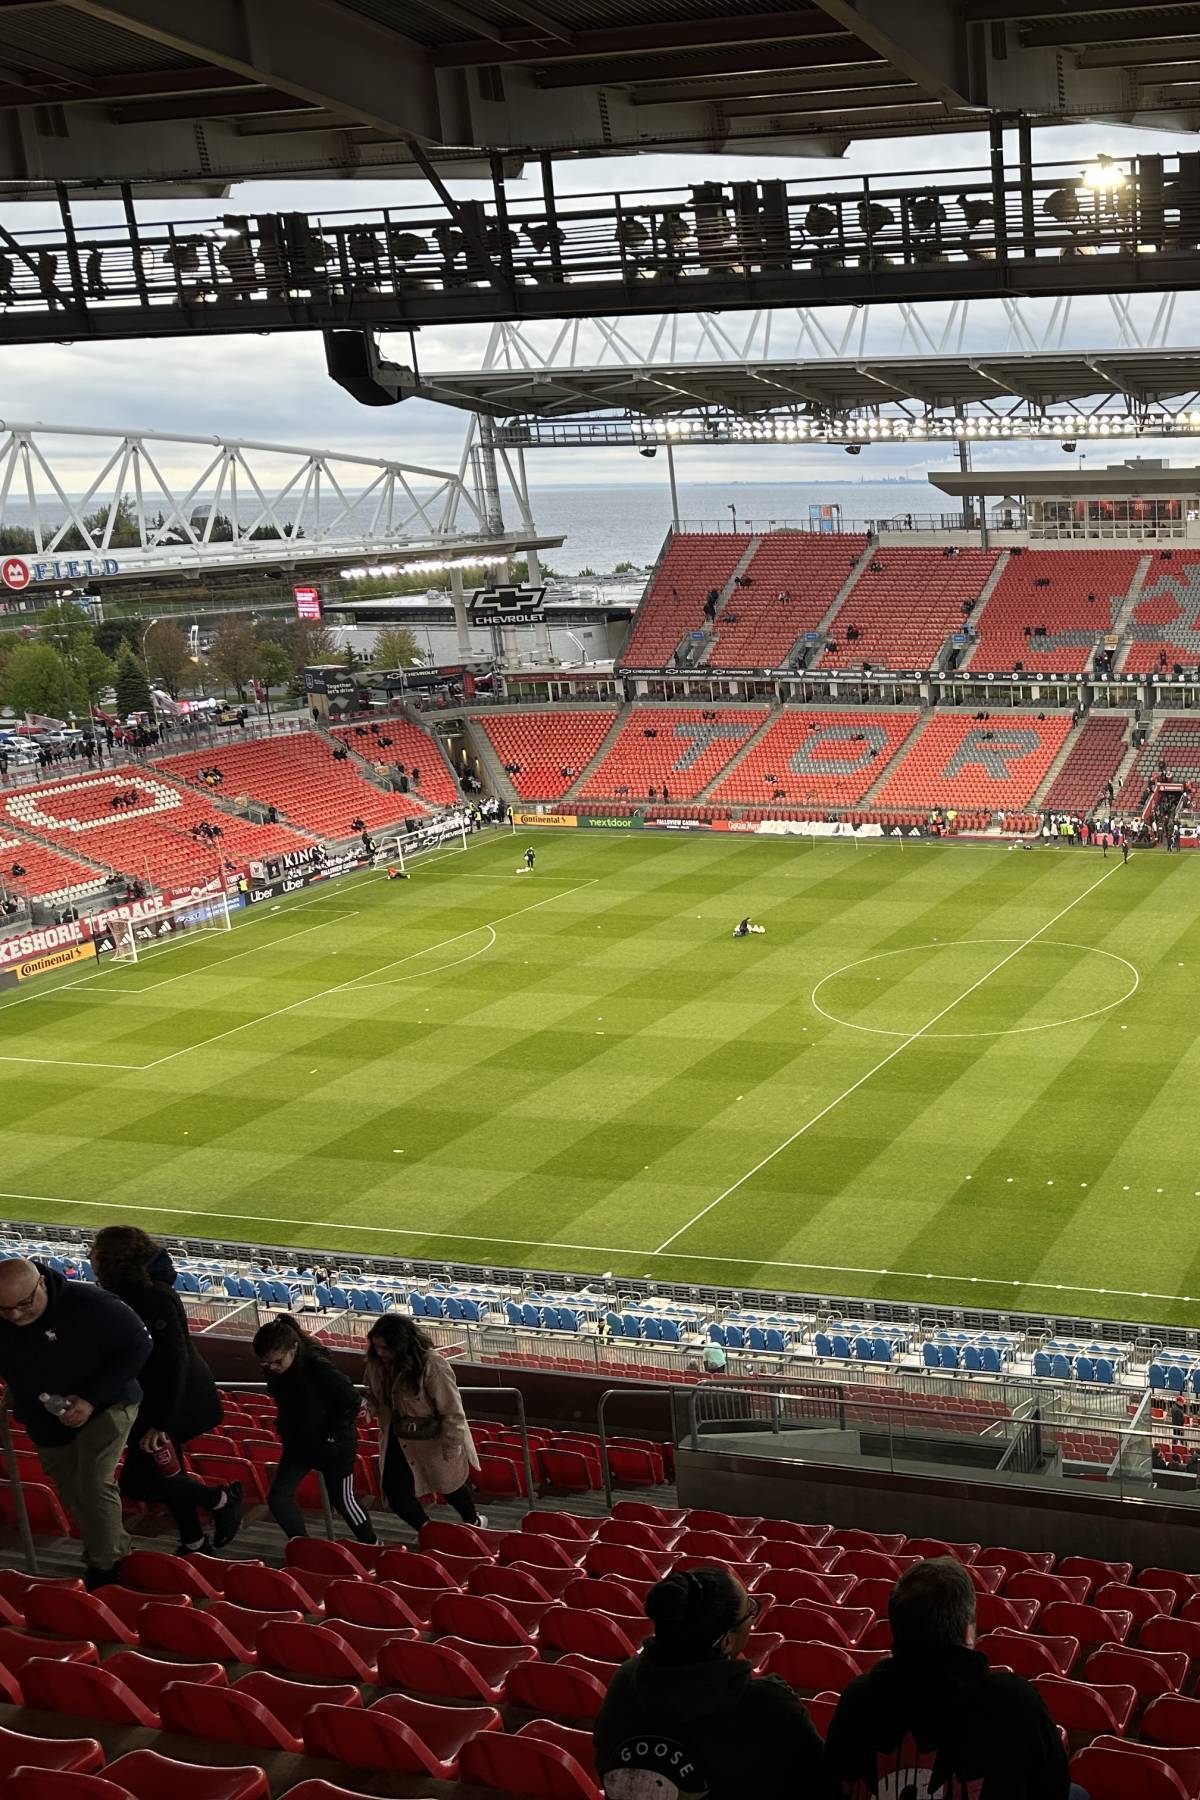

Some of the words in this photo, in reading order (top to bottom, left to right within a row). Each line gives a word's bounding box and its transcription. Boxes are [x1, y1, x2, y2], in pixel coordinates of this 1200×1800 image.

[33, 559, 119, 580] FIELD
[475, 614, 545, 625] CHEVROLET
[520, 815, 560, 824] Continental
[589, 818, 633, 828] nextdoor
[282, 879, 304, 893] Uber
[250, 888, 273, 903] Uber
[84, 896, 164, 935] TERRACE
[21, 950, 74, 977] Continental
[621, 1742, 694, 1778] GOOSE
